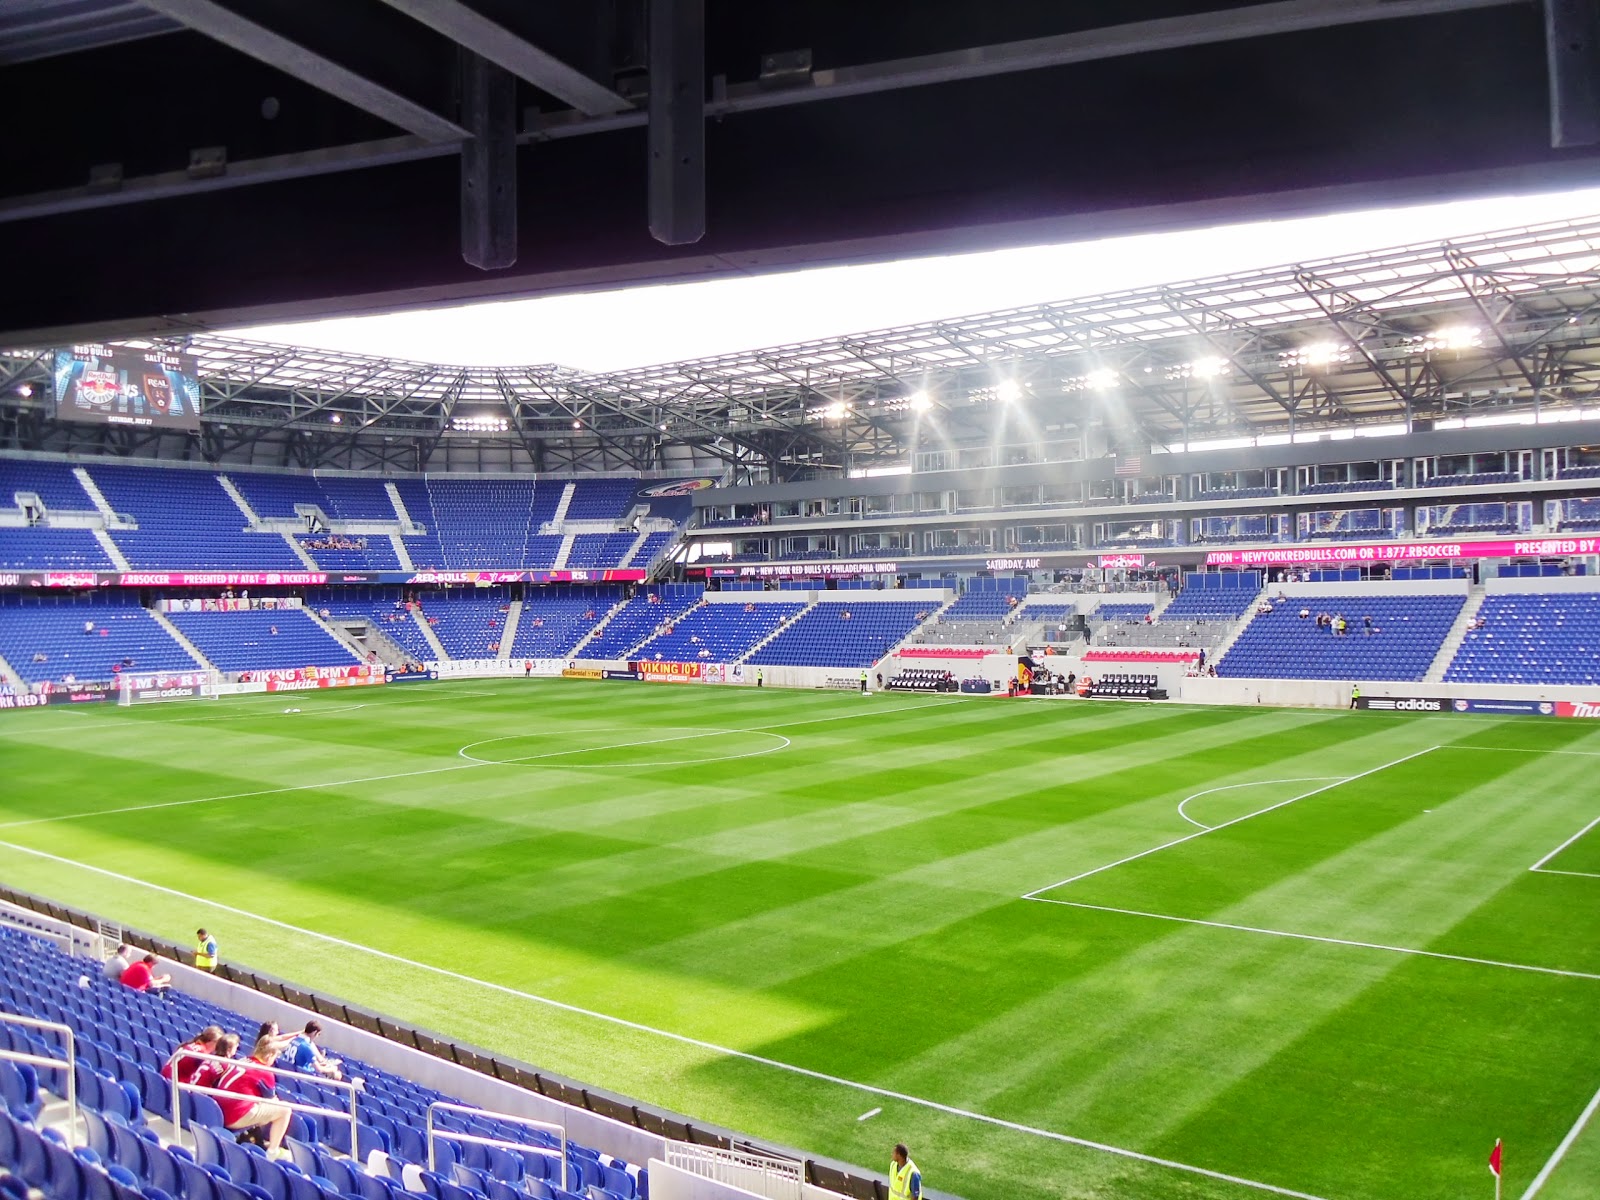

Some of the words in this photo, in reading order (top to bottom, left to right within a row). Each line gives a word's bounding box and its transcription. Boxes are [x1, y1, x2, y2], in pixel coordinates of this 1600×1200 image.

[144, 354, 161, 363] SALT
[161, 356, 180, 364] LAKE
[122, 384, 139, 398] VS
[1515, 541, 1576, 553] PRESENTED
[1580, 540, 1595, 551] BY
[1207, 553, 1233, 563] ATION
[1242, 548, 1356, 562] NEWYORKREDBULLS.COM
[1360, 547, 1374, 558] OR
[1378, 545, 1461, 558] 1.877.RBSOCCER
[760, 567, 773, 575] NEW
[775, 566, 791, 574] YORK
[792, 566, 803, 574] RED
[805, 565, 821, 574] BULLS
[823, 565, 831, 573] VS
[832, 564, 873, 573] PHILADELPHIA
[875, 563, 896, 572] UNION
[986, 559, 1023, 569] SATURDAY,
[184, 574, 226, 584] PRESENTED
[228, 574, 239, 584] BY
[240, 574, 259, 584] AT&T
[266, 574, 281, 584] FOR
[283, 574, 310, 584] TICKETS
[312, 574, 318, 583] &
[416, 573, 434, 583] RED
[437, 573, 467, 583] BULLS
[572, 571, 588, 580] RSL
[641, 663, 679, 676] VIKING
[161, 688, 192, 697] adidas
[17, 695, 38, 707] RED
[1396, 700, 1441, 711] adidas
